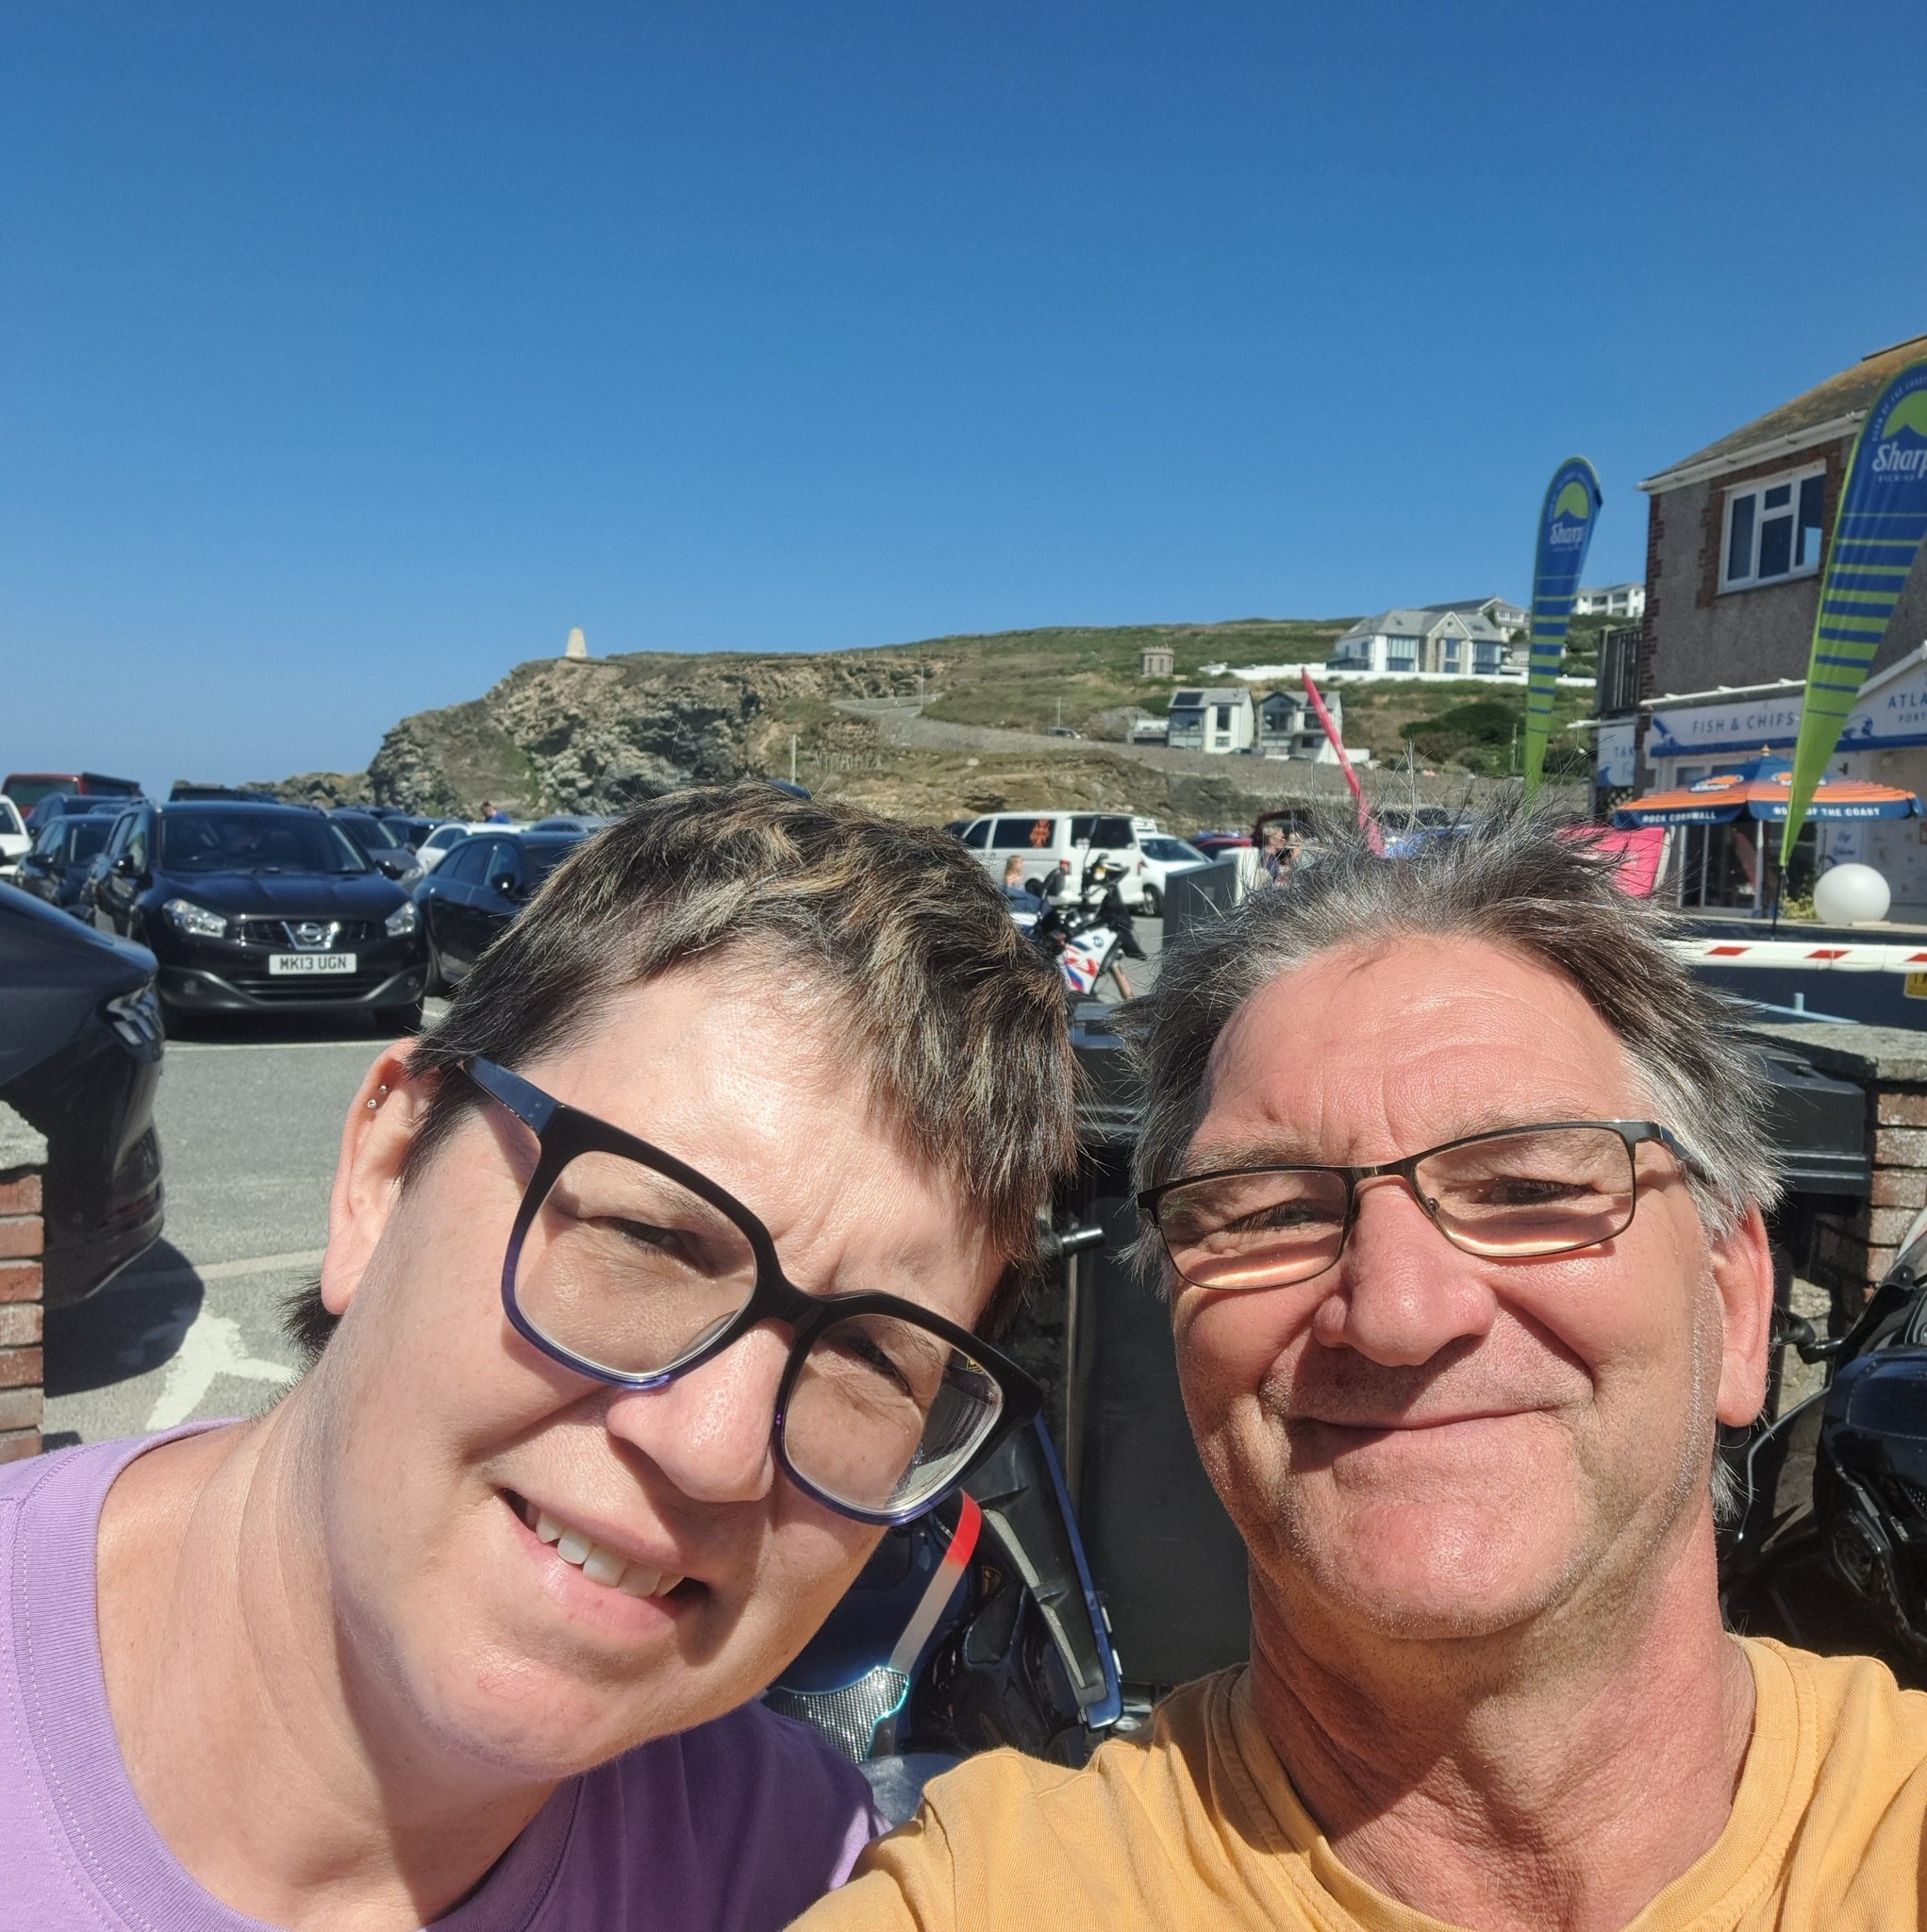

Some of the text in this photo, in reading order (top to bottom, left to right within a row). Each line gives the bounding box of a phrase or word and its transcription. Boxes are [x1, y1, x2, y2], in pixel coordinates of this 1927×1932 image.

[1693, 712, 1793, 734] FISH & CHIPS
[1820, 808, 1842, 817] THE
[1844, 808, 1880, 817] COAST
[279, 956, 347, 970] MK13 UGN
